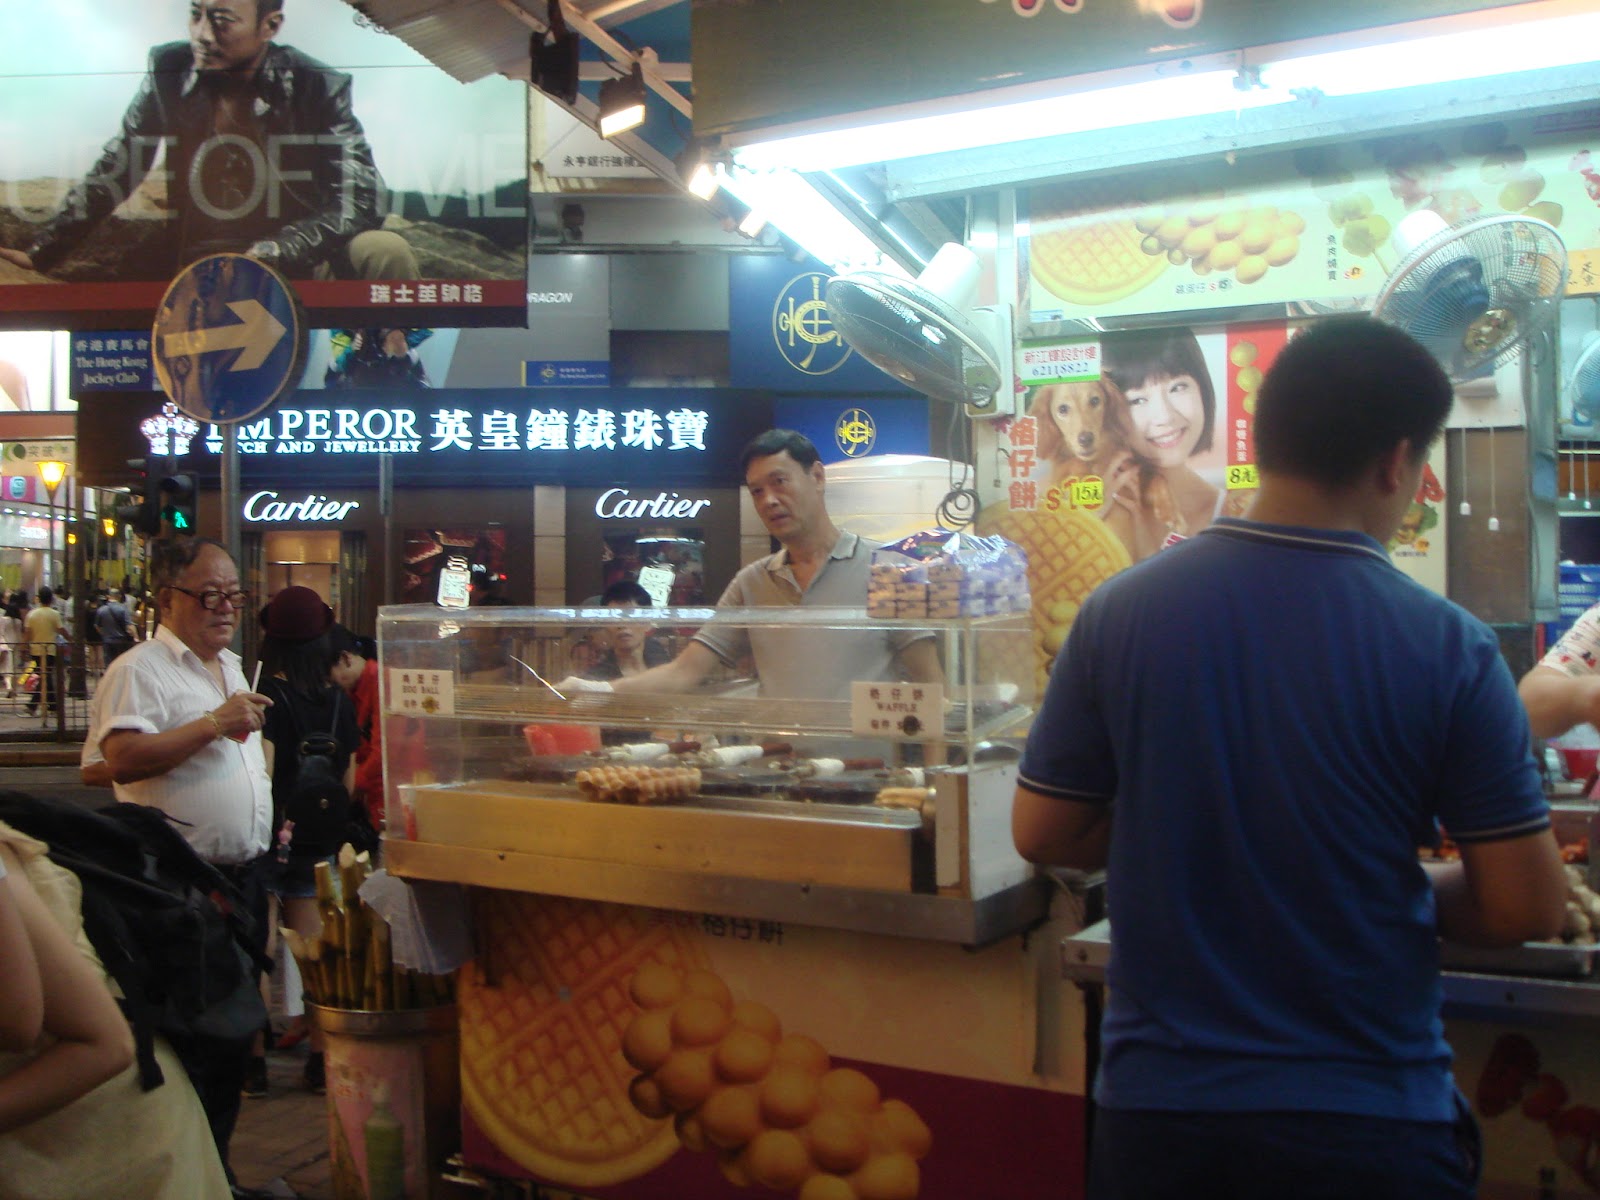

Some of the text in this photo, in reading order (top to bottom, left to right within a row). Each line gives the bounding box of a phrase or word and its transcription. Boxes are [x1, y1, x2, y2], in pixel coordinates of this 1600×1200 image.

[189, 134, 313, 219] OF
[316, 134, 528, 218] TIME
[76, 357, 148, 370] The Hong Kong
[82, 372, 140, 386] Jockey Club
[430, 408, 709, 451] 英皇鐘錶珠寶
[206, 441, 422, 454] WCH AND JEWELLERY
[1008, 416, 1037, 510] 格仔餅
[244, 490, 360, 521] Cartier
[595, 488, 710, 518] Cartier
